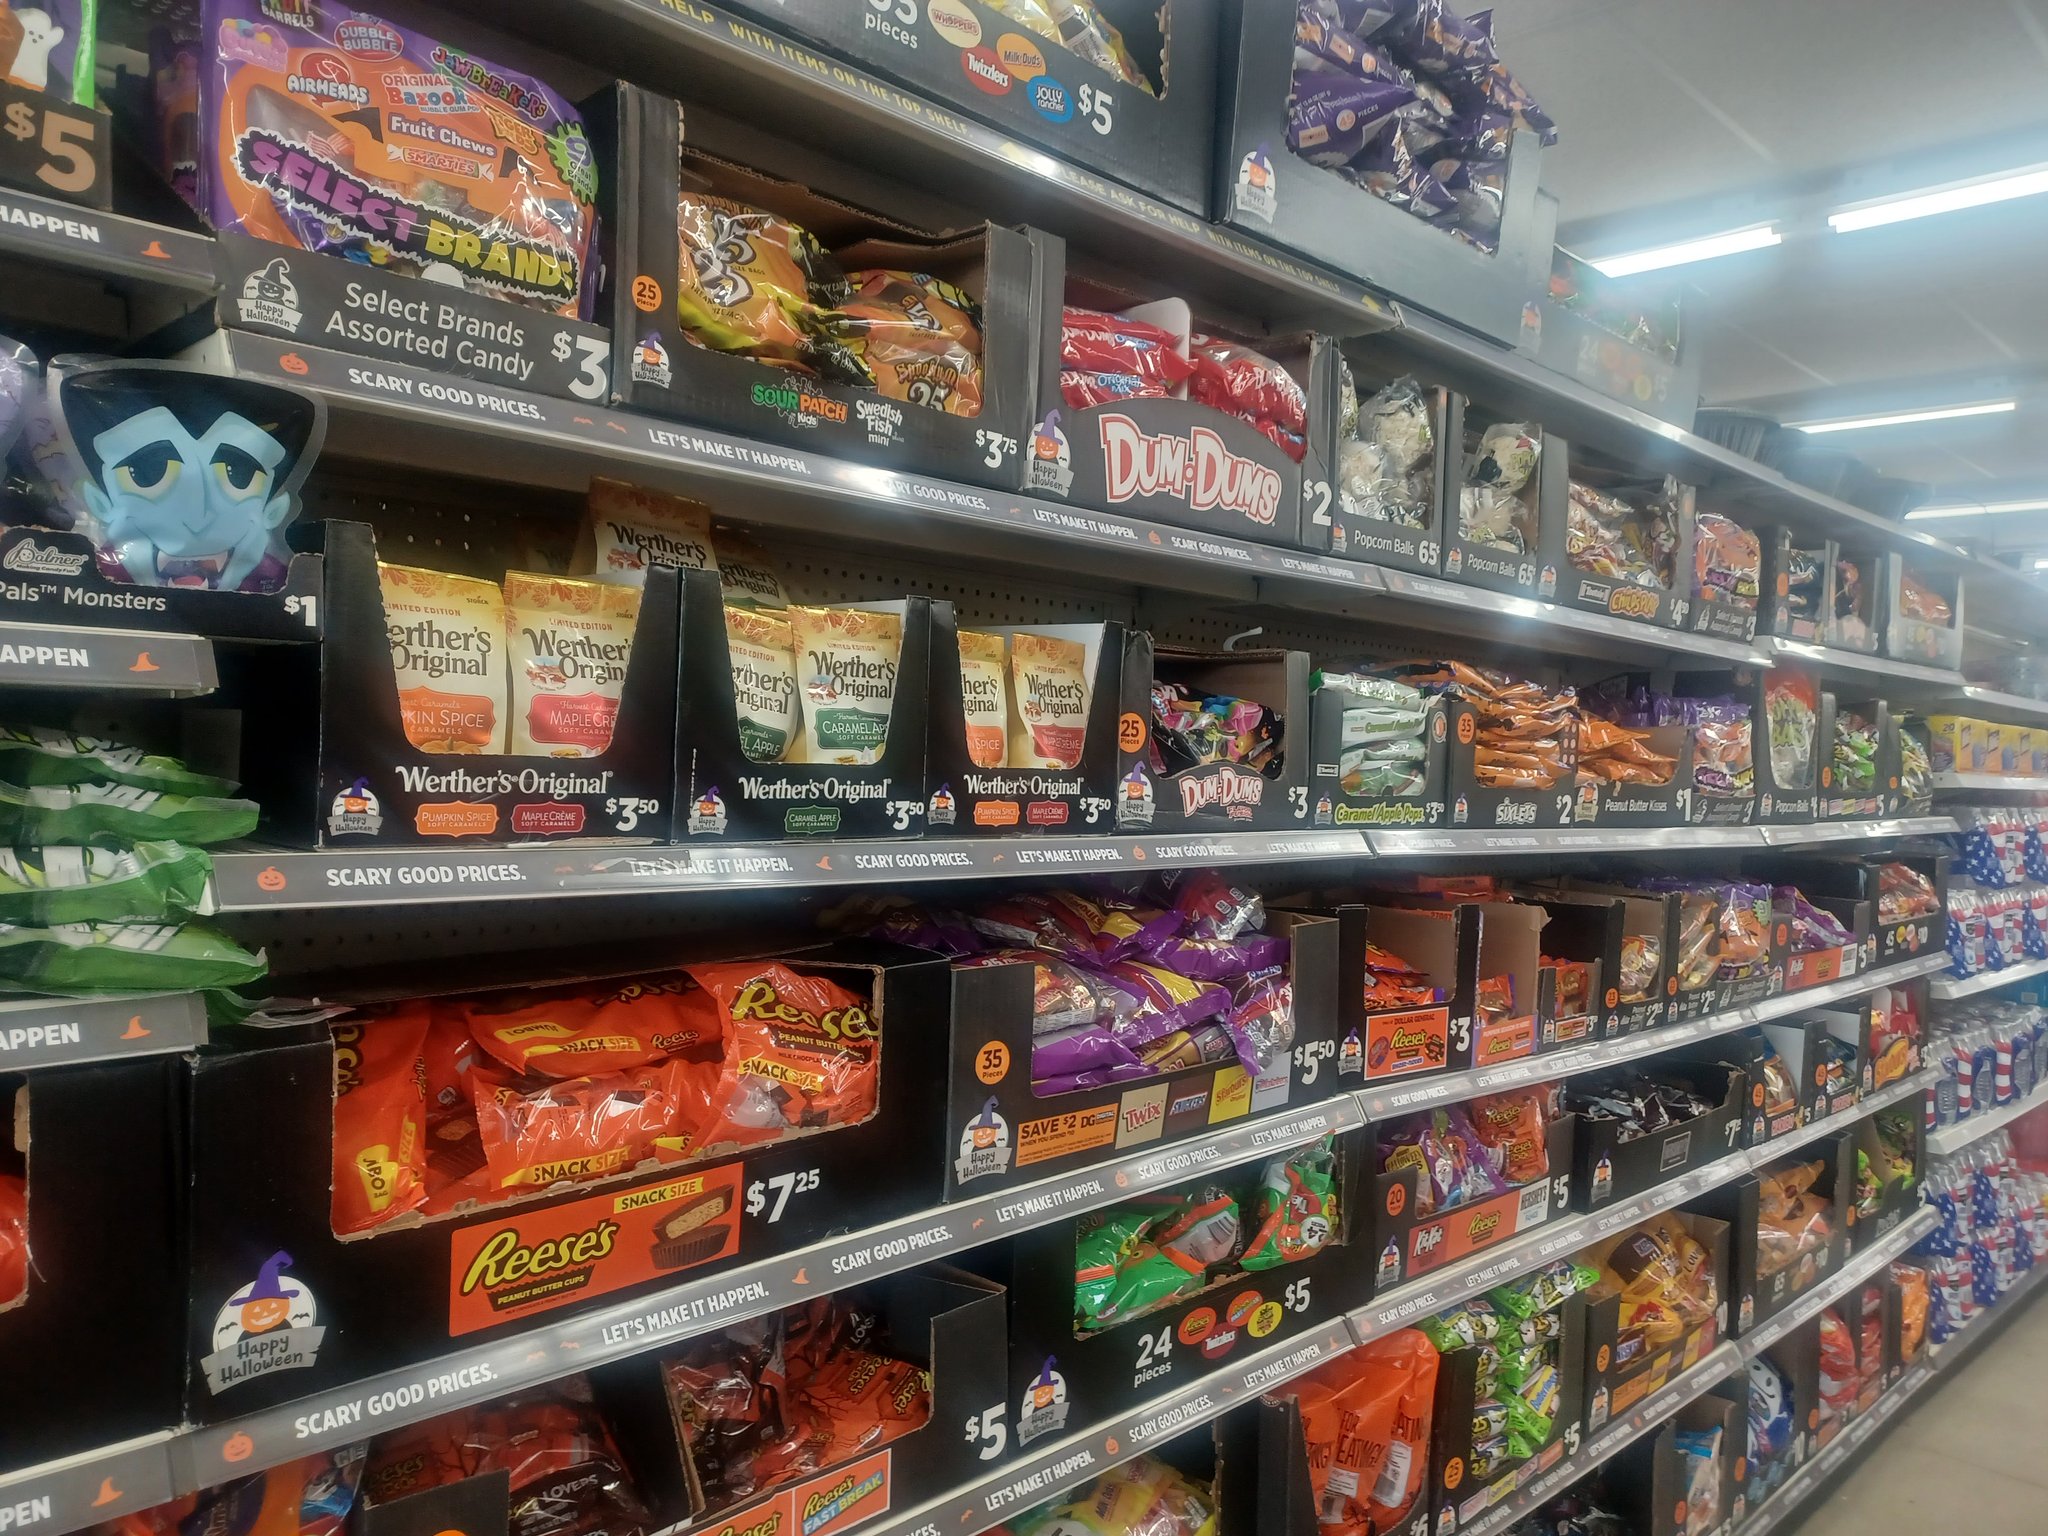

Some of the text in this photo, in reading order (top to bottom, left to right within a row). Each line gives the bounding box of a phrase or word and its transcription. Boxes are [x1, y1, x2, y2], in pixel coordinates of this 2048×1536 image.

[339, 26, 395, 42] DUBBLE
[863, 11, 919, 49] pieces
[932, 9, 979, 35] WHOPPERS
[342, 39, 397, 53] BUBBLE
[1004, 50, 1041, 67] Milk Duds
[382, 74, 451, 87] ORIGINAL
[727, 22, 777, 50] WITH
[779, 39, 831, 75] ITEMS
[833, 66, 859, 87] ON
[862, 75, 892, 103] THE
[895, 87, 924, 113] TOP
[967, 53, 1009, 88] Twizzlers
[287, 75, 369, 105] AIRHEADS
[1036, 84, 1063, 102] JOLLY
[1037, 100, 1065, 112] rancher
[1078, 83, 1113, 136] $5
[3, 102, 96, 192] $5
[390, 116, 438, 140] Fruit
[439, 129, 497, 157] Chews
[406, 151, 476, 174] SMARTIES
[569, 161, 593, 182] Great
[249, 141, 420, 242] SELECT
[0, 205, 100, 243] HAPPEN
[424, 219, 574, 292] BRANDS
[637, 281, 657, 300] 25
[246, 309, 291, 328] Halloween
[254, 301, 284, 318] Happy
[344, 282, 525, 347] Select Brands
[325, 310, 535, 382] Assorted Candy
[550, 331, 610, 400] $3
[348, 369, 546, 421] SCARY GOOD PRICES.
[752, 383, 848, 422] SOUR PATCH
[798, 411, 818, 426] Kids
[857, 400, 903, 425] Swedish
[866, 414, 892, 435] Fish
[648, 428, 811, 474] LET'S MAKE IT HAPPEN.
[868, 432, 890, 447] mini
[1302, 479, 1332, 526] $2
[1354, 530, 1392, 552] Popcorn
[1394, 538, 1414, 556] Balls
[1467, 554, 1516, 577] Popcorn Balls
[64, 587, 166, 612] Monsters
[284, 595, 317, 627] $1
[580, 621, 613, 631] EDITION
[809, 650, 896, 680] Werther's
[831, 676, 894, 699] Original
[1024, 673, 1084, 699] Werther's
[1039, 698, 1084, 718] Original
[1121, 719, 1139, 737] 25
[1459, 718, 1472, 732] 35
[395, 766, 608, 800] Werther's Original
[738, 777, 887, 803] Werther's Original
[964, 774, 1081, 798] Werther's Original
[1289, 786, 1308, 819] $3
[1336, 806, 1375, 824] Caramel
[1376, 804, 1402, 824] Apple
[1556, 795, 1572, 824] $2
[1605, 799, 1667, 812] Peanut Butter Kisses
[1676, 788, 1692, 821] $1
[421, 810, 493, 823] PUMPKIN SPICE
[521, 811, 549, 822] MAPLE
[789, 813, 837, 823] CARAMEL APPLE
[327, 864, 527, 888] SCARY GOOD PRICES.
[1394, 1014, 1416, 1026] DOLLAR
[1450, 1016, 1471, 1052] $3
[981, 1048, 1003, 1069] 35
[1021, 1114, 1077, 1140] SAVE $2
[1122, 1101, 1162, 1131] Twix
[1251, 1131, 1270, 1145] LET'S
[1270, 1125, 1288, 1140] MAKE
[1296, 1115, 1327, 1134] HAPPEN
[620, 1179, 698, 1211] SNACK SIZE
[1388, 1188, 1403, 1205] 20
[1553, 1174, 1569, 1209] $5
[498, 1288, 531, 1305] PEANUT
[532, 1281, 564, 1297] BUTTER
[564, 1274, 585, 1288] CUPS
[1284, 1276, 1312, 1313] $5
[601, 1281, 769, 1345] LET'S MAKE IT HAPPEN.
[1378, 1310, 1399, 1325] SCARY
[1399, 1303, 1415, 1317] GOOD
[236, 1335, 290, 1361] Happy
[1136, 1325, 1173, 1368] 24
[219, 1351, 304, 1384] Halloween
[1133, 1360, 1173, 1388] pieces
[294, 1362, 498, 1439] SCARY GOOD PRICES.
[964, 1402, 1007, 1462] $5
[1340, 1408, 1361, 1431] FOR
[1564, 1421, 1581, 1456] $5
[1336, 1437, 1382, 1470] EATING!
[802, 1476, 883, 1536] FAST BREAK
